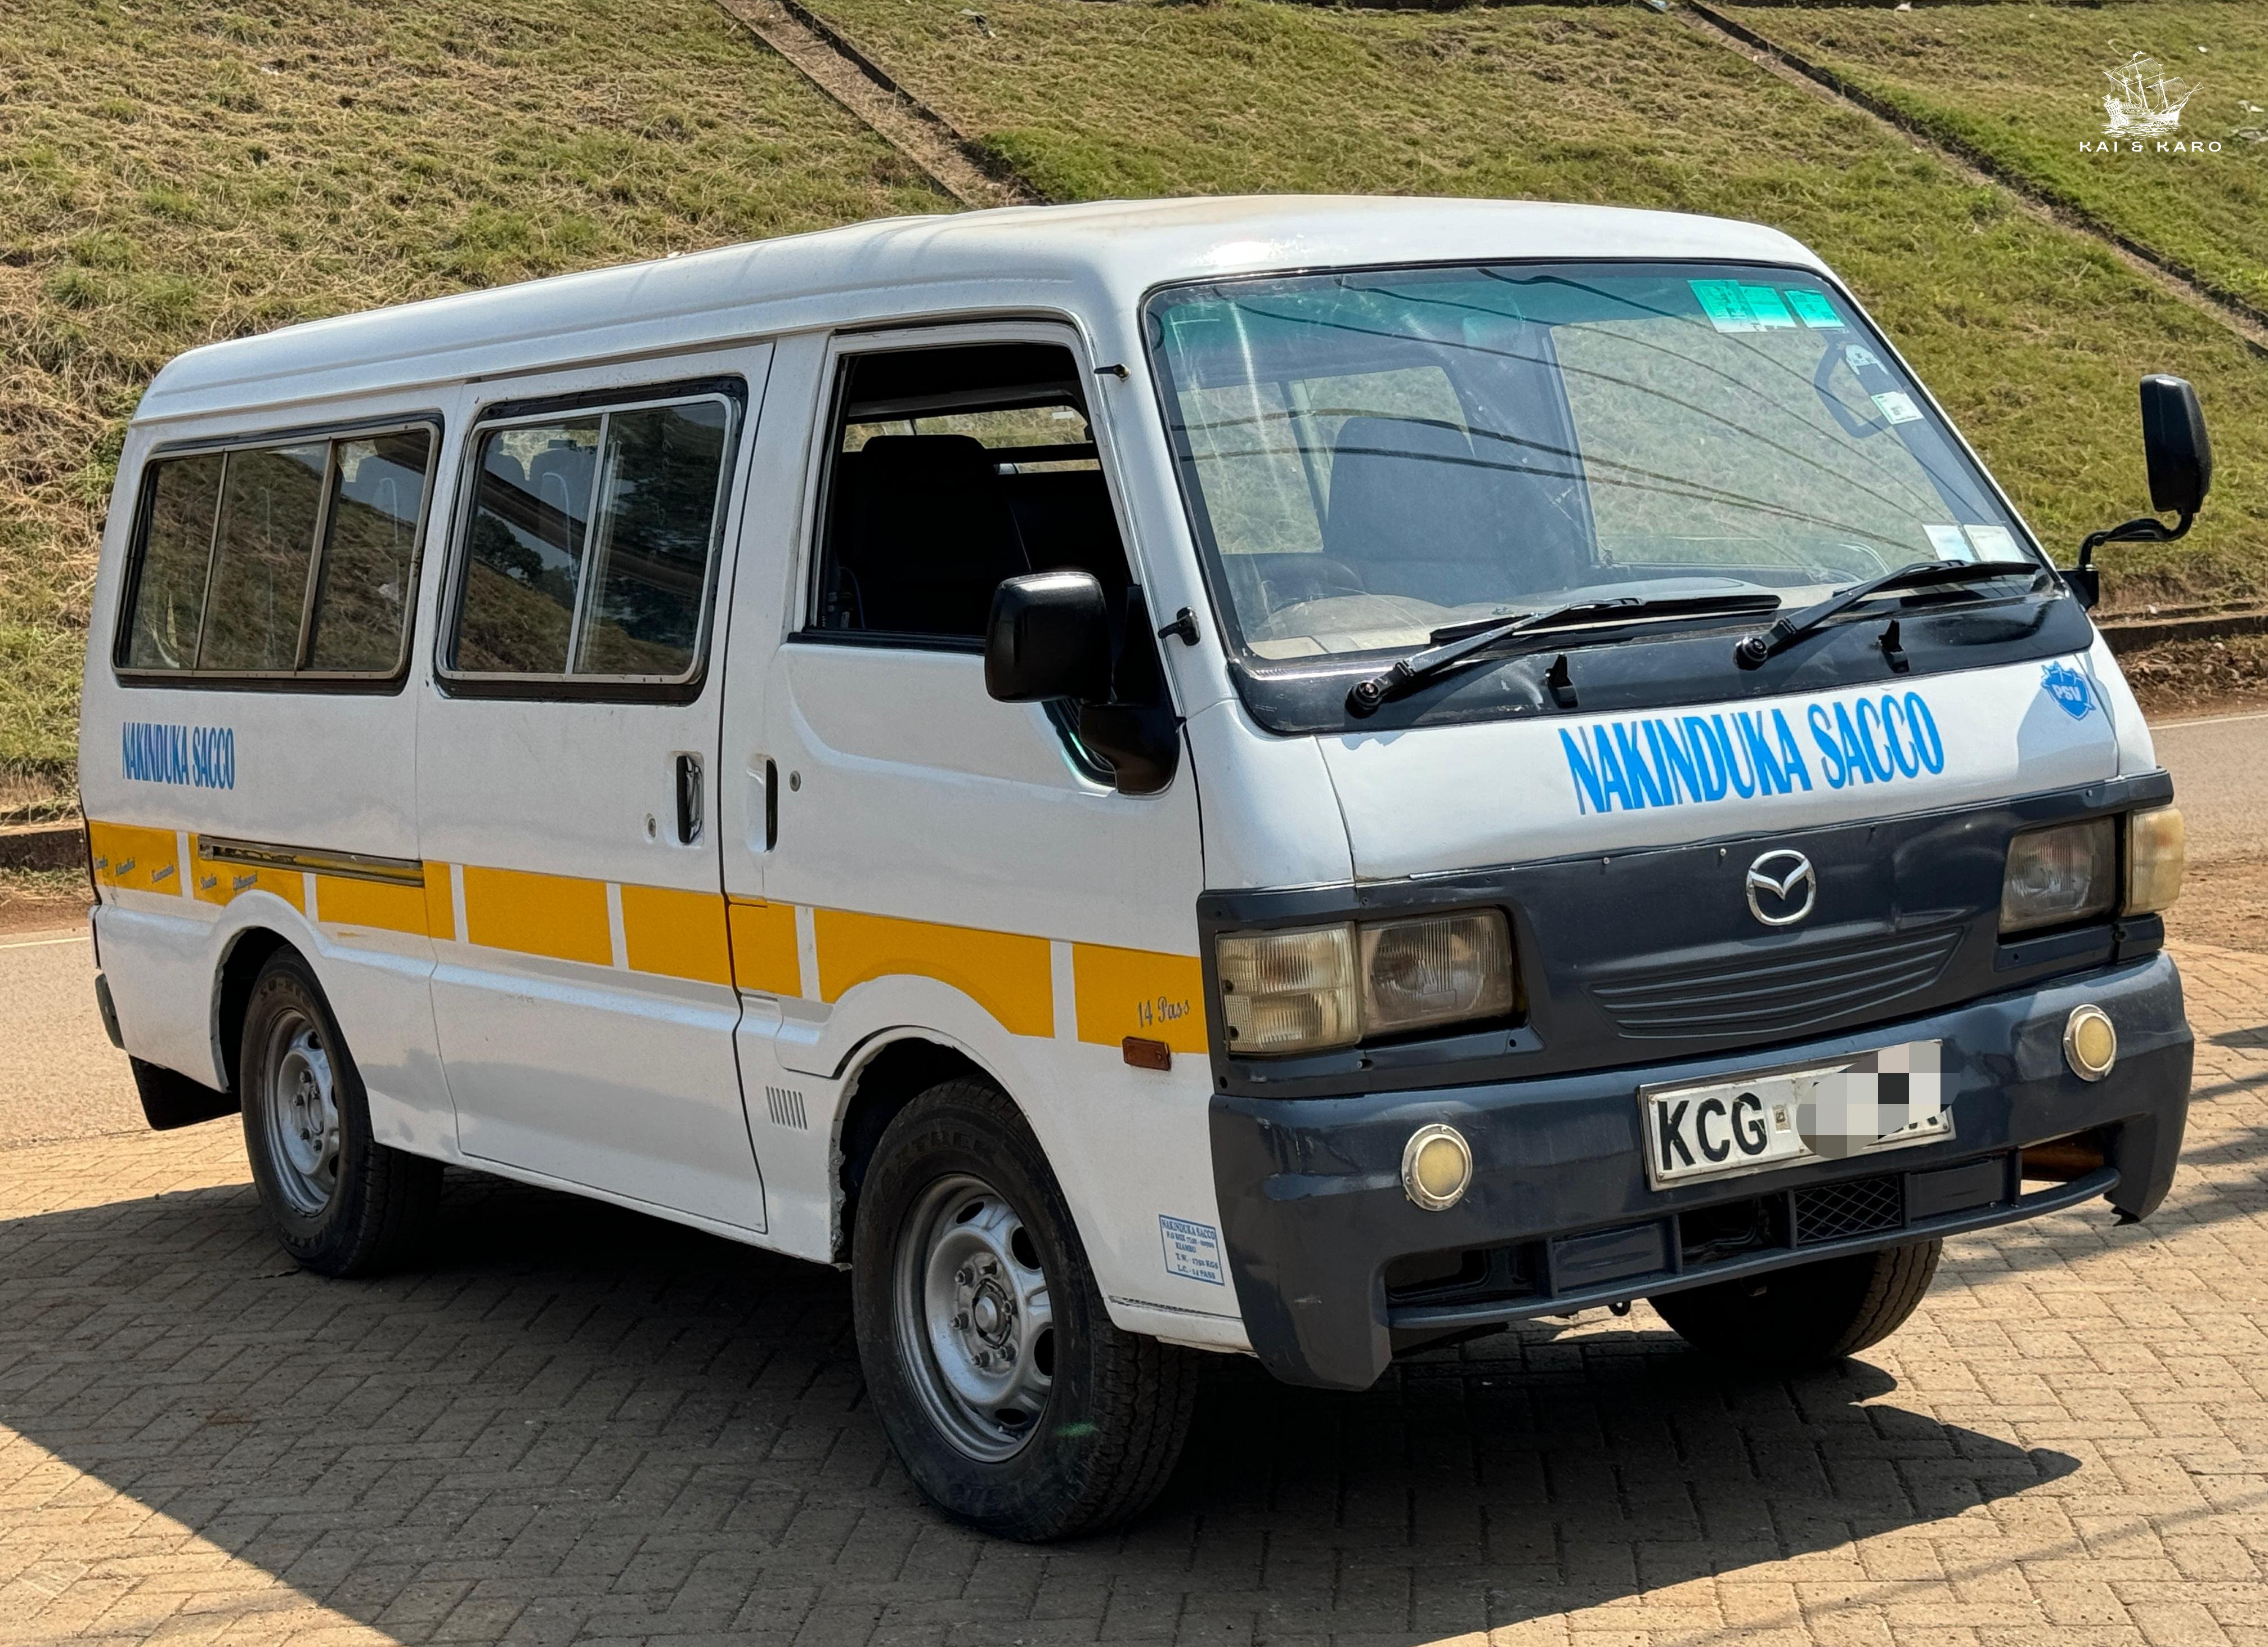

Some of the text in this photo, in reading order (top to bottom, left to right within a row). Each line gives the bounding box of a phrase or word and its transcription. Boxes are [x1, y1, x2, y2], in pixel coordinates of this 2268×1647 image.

[2052, 684, 2082, 702] PSV
[123, 721, 235, 790] NAKINDUKA SACCO
[1557, 692, 1945, 815] NAKINDUKA SACCO
[1138, 996, 1189, 1028] 14 Pass
[1657, 1092, 1769, 1171] KCG
[1162, 1219, 1215, 1240] NAKINDUKA SACCO
[1199, 1270, 1216, 1279] PASS
